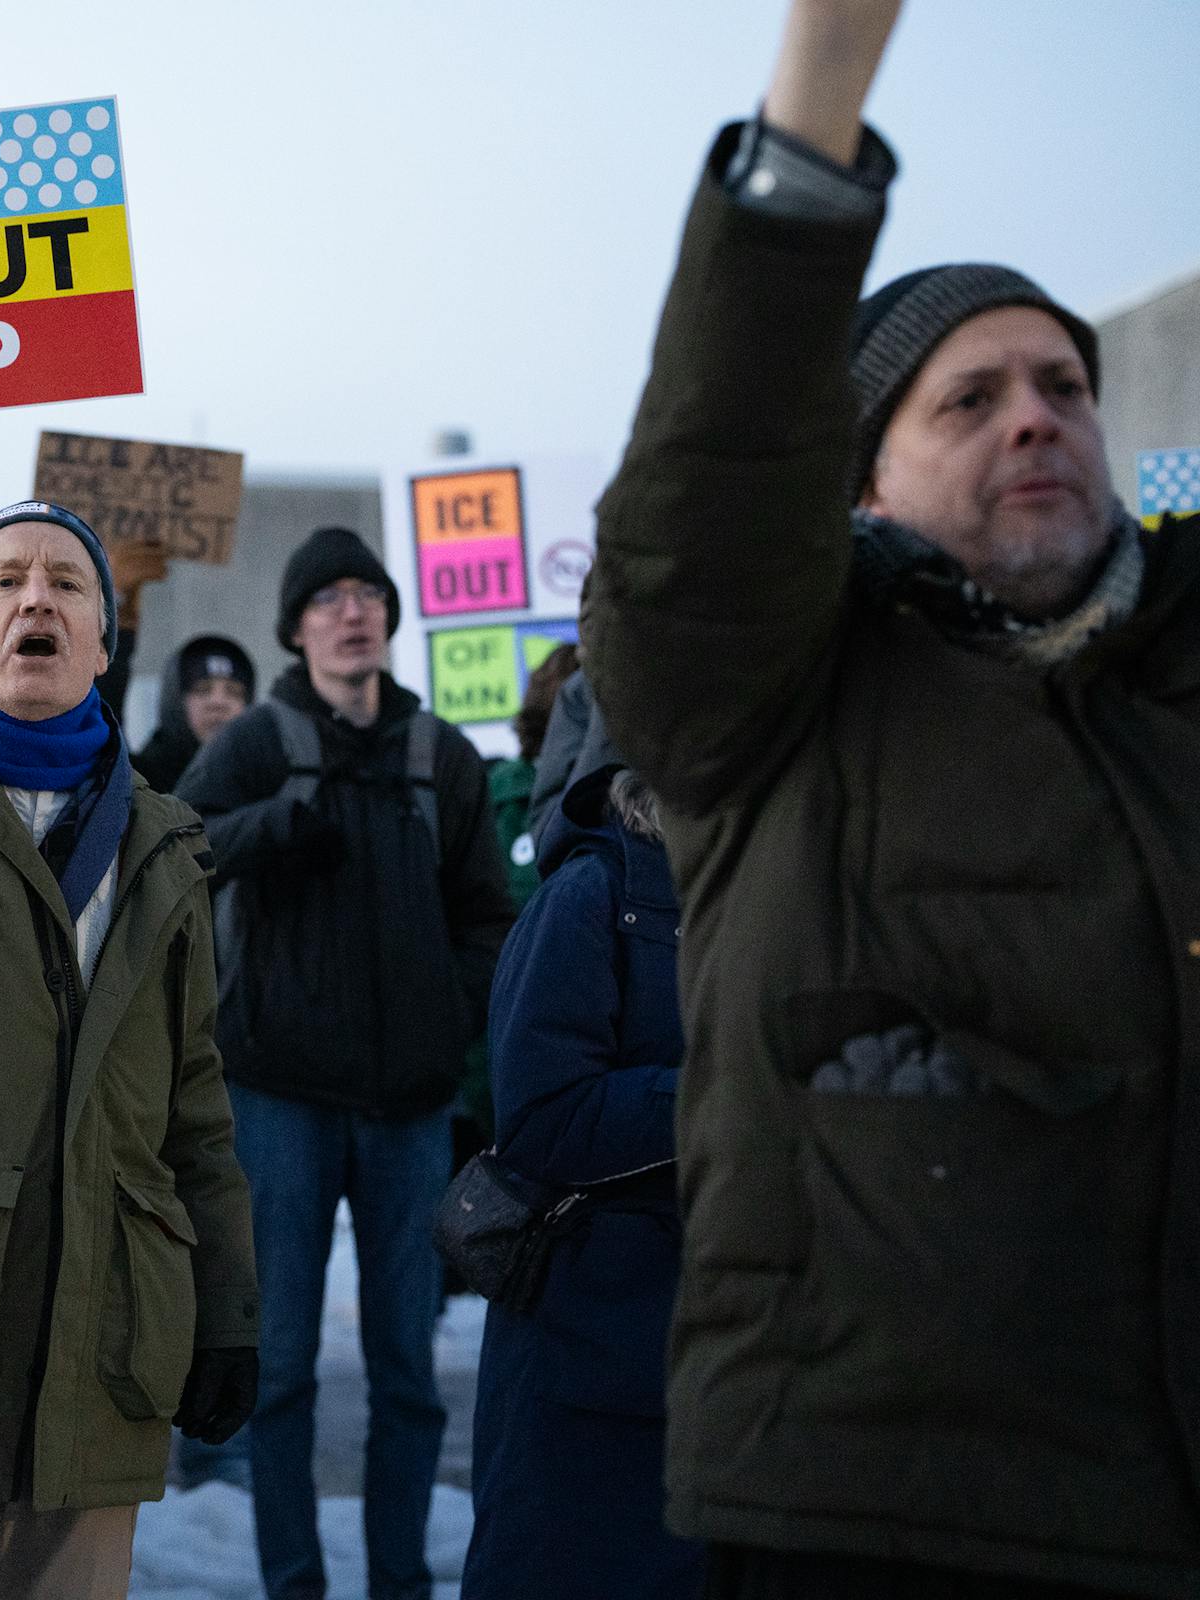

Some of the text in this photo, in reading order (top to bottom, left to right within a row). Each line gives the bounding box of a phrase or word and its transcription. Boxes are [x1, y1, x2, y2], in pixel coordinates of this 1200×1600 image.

[434, 490, 496, 532] ICE
[432, 559, 512, 602] OUT
[445, 637, 500, 669] OF
